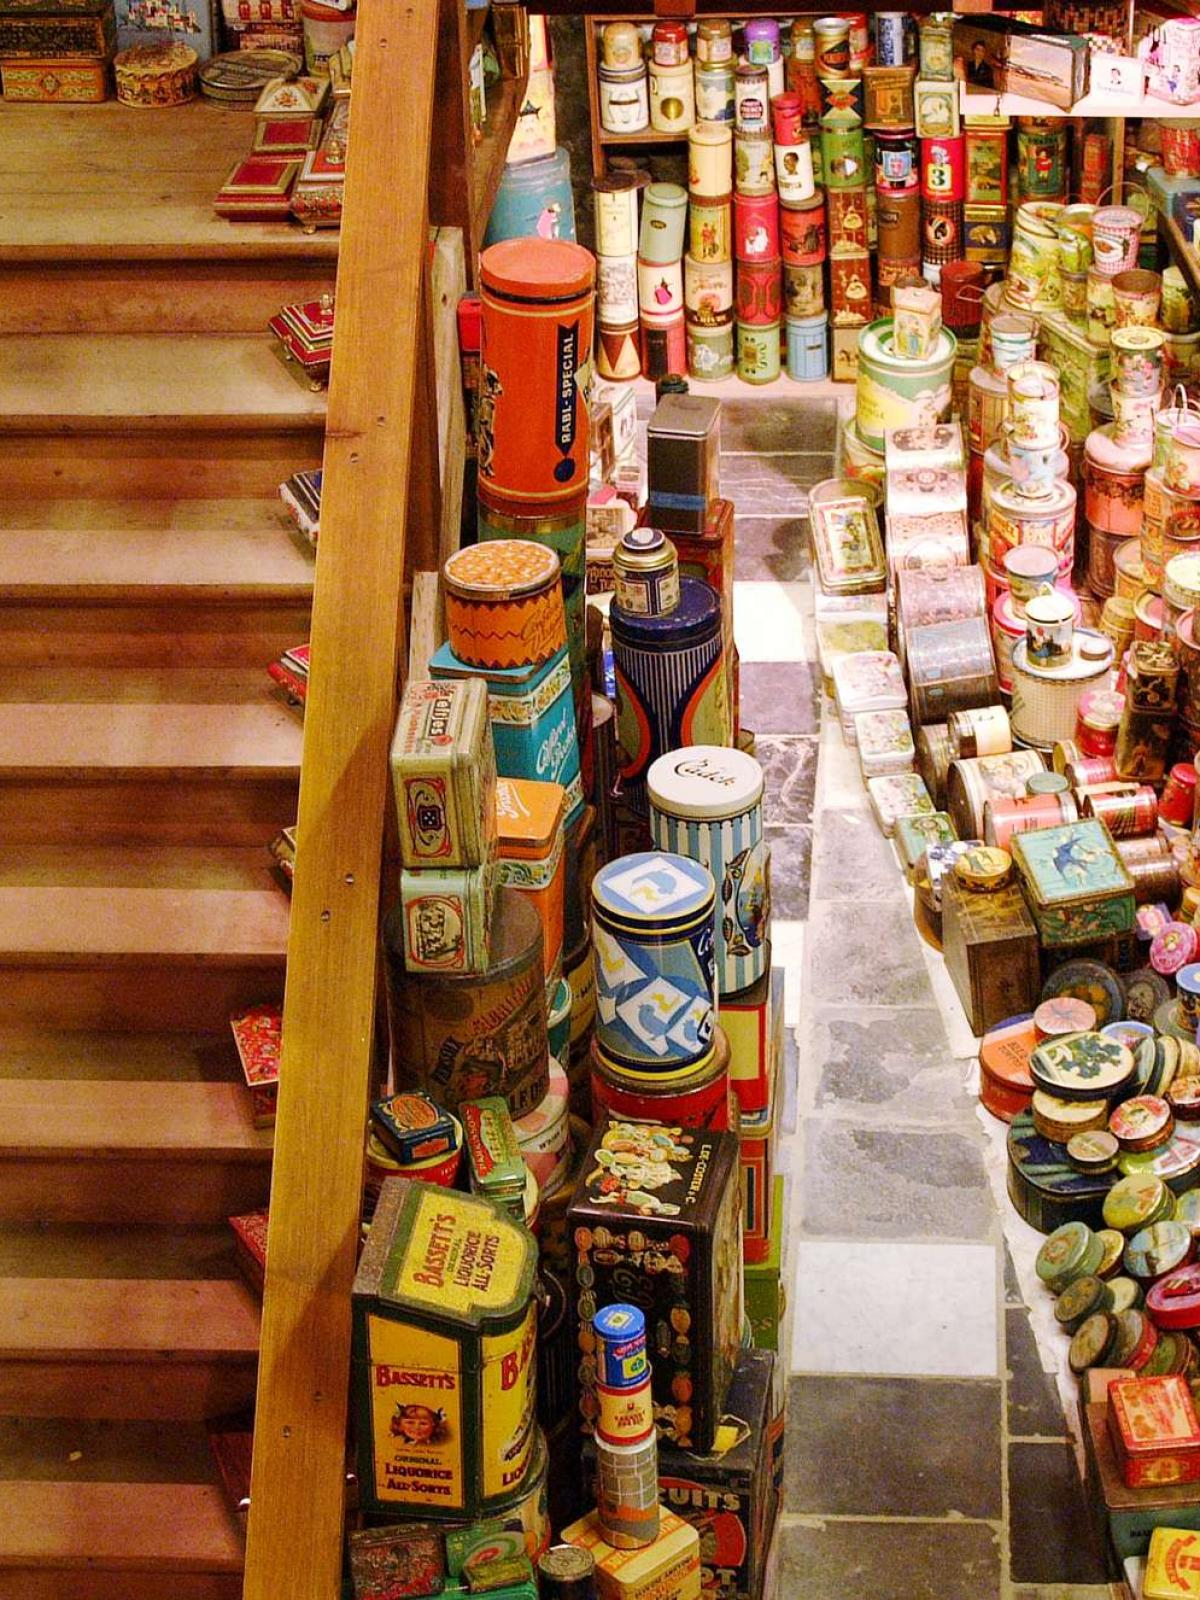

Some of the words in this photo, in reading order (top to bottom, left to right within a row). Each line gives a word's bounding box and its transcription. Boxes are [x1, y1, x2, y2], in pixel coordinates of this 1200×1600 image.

[931, 168, 946, 187] 3
[413, 1213, 457, 1288] BASSETT'S
[453, 1230, 481, 1288] LIQUORICE
[376, 1364, 456, 1390] BASSETT'S
[385, 1462, 453, 1480] LIQUORICE
